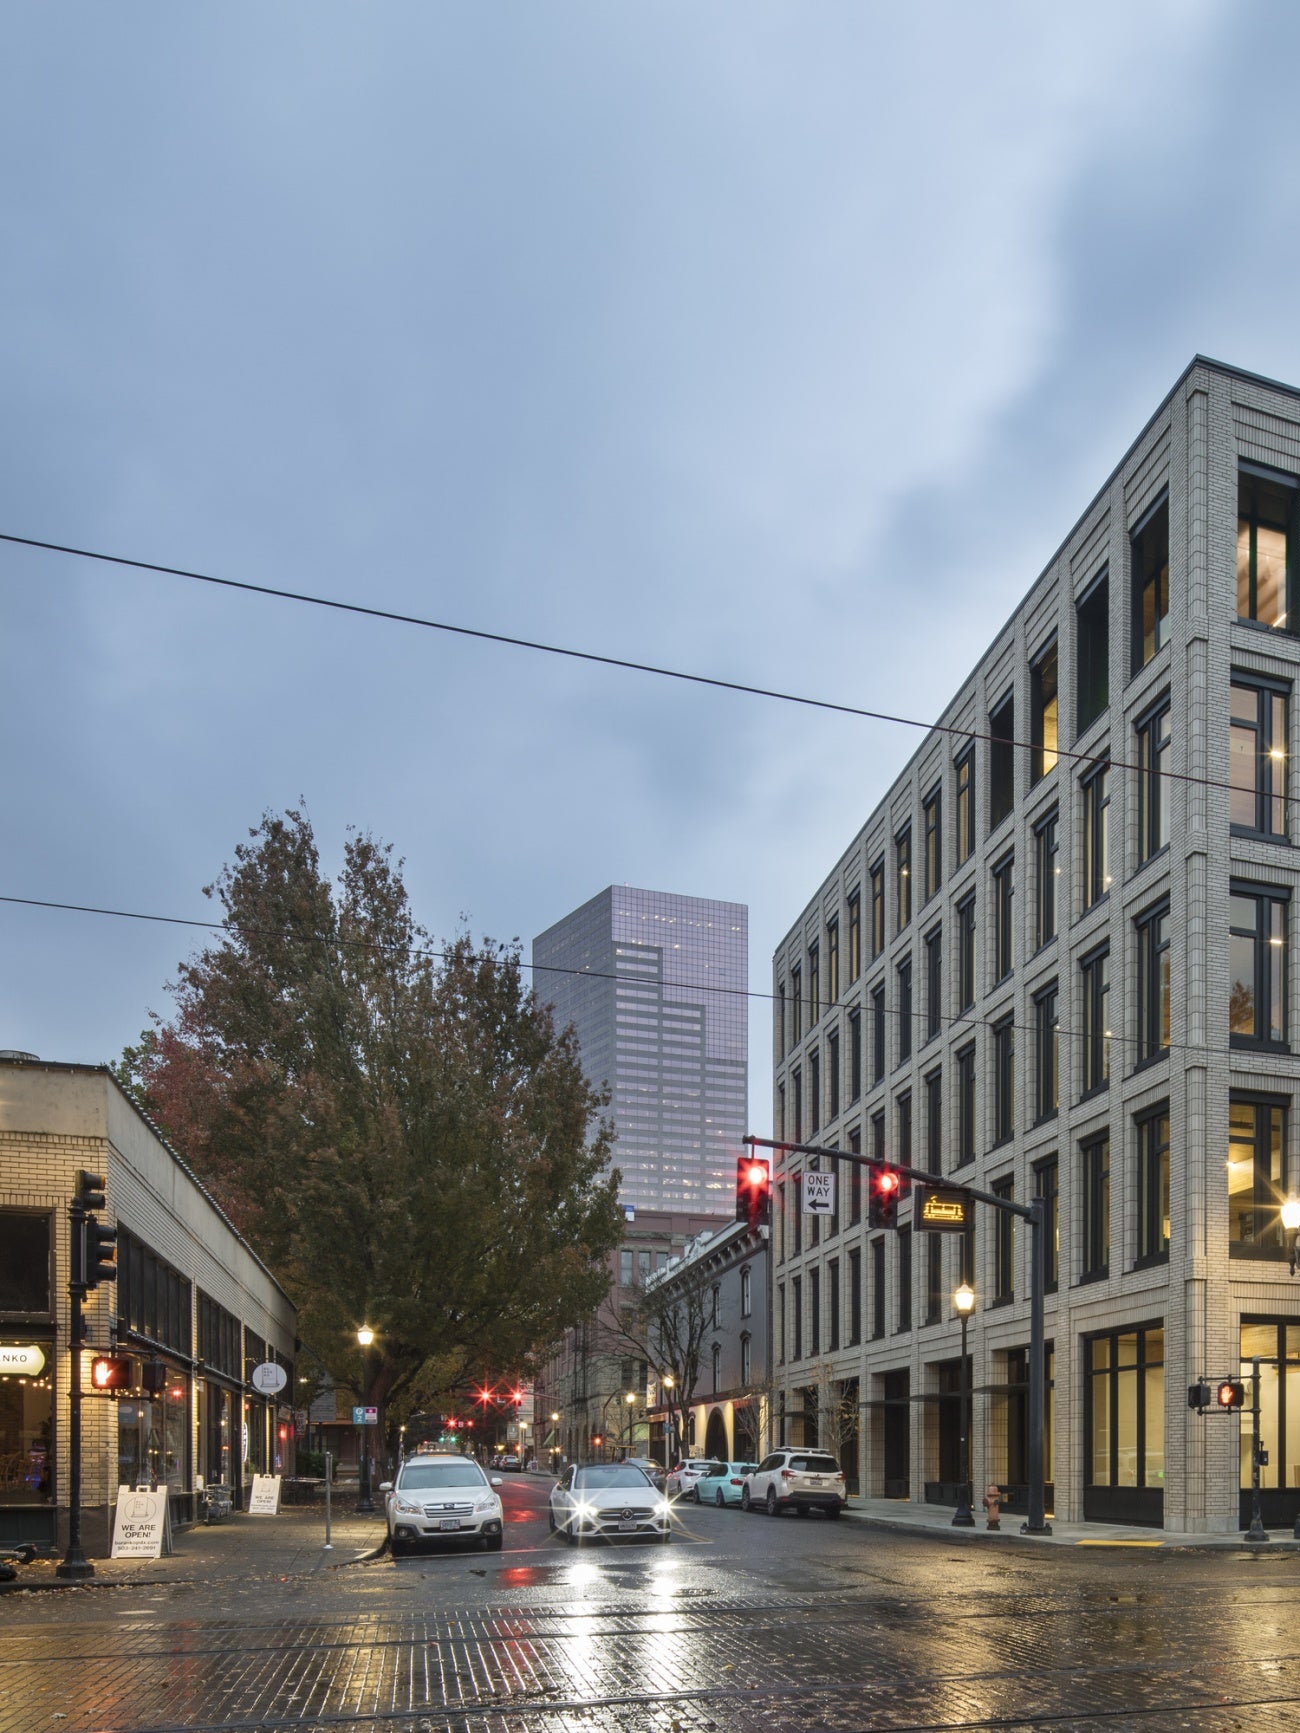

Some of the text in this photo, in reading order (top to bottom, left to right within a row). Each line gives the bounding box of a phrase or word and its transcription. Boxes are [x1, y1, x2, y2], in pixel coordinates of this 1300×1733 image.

[808, 1174, 830, 1186] ONE
[807, 1186, 830, 1197] WAY
[0, 1354, 28, 1363] NKO
